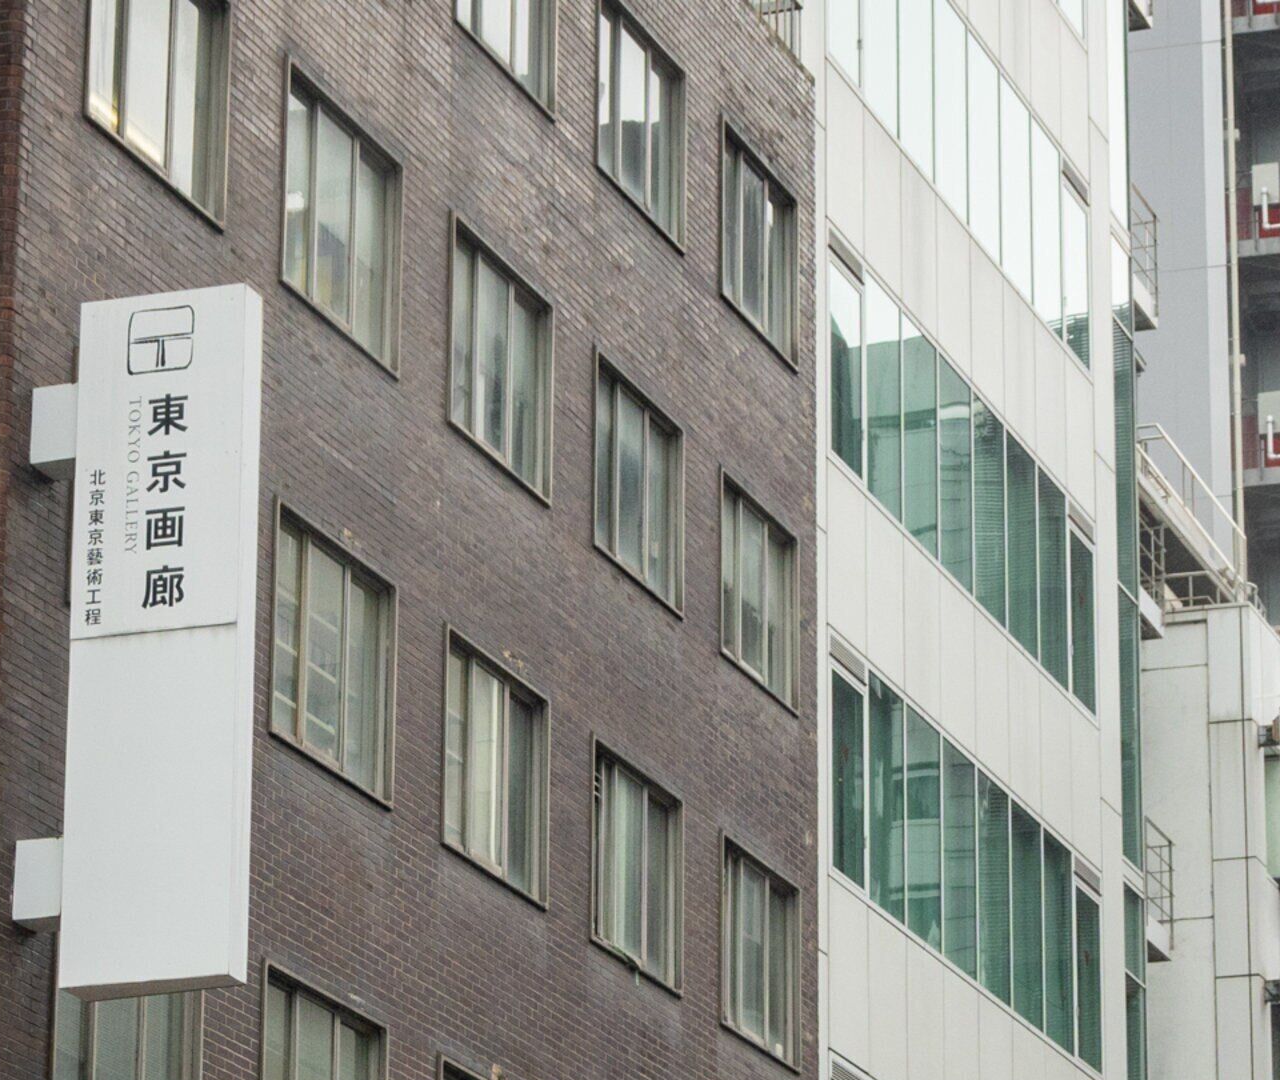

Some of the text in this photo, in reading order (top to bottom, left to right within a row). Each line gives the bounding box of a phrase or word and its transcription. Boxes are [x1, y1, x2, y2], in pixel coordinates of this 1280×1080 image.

[84, 468, 107, 626] 北京東京藝術工程
[124, 396, 143, 555] TOKYO GALLERY
[141, 392, 190, 610] 東京画廊
